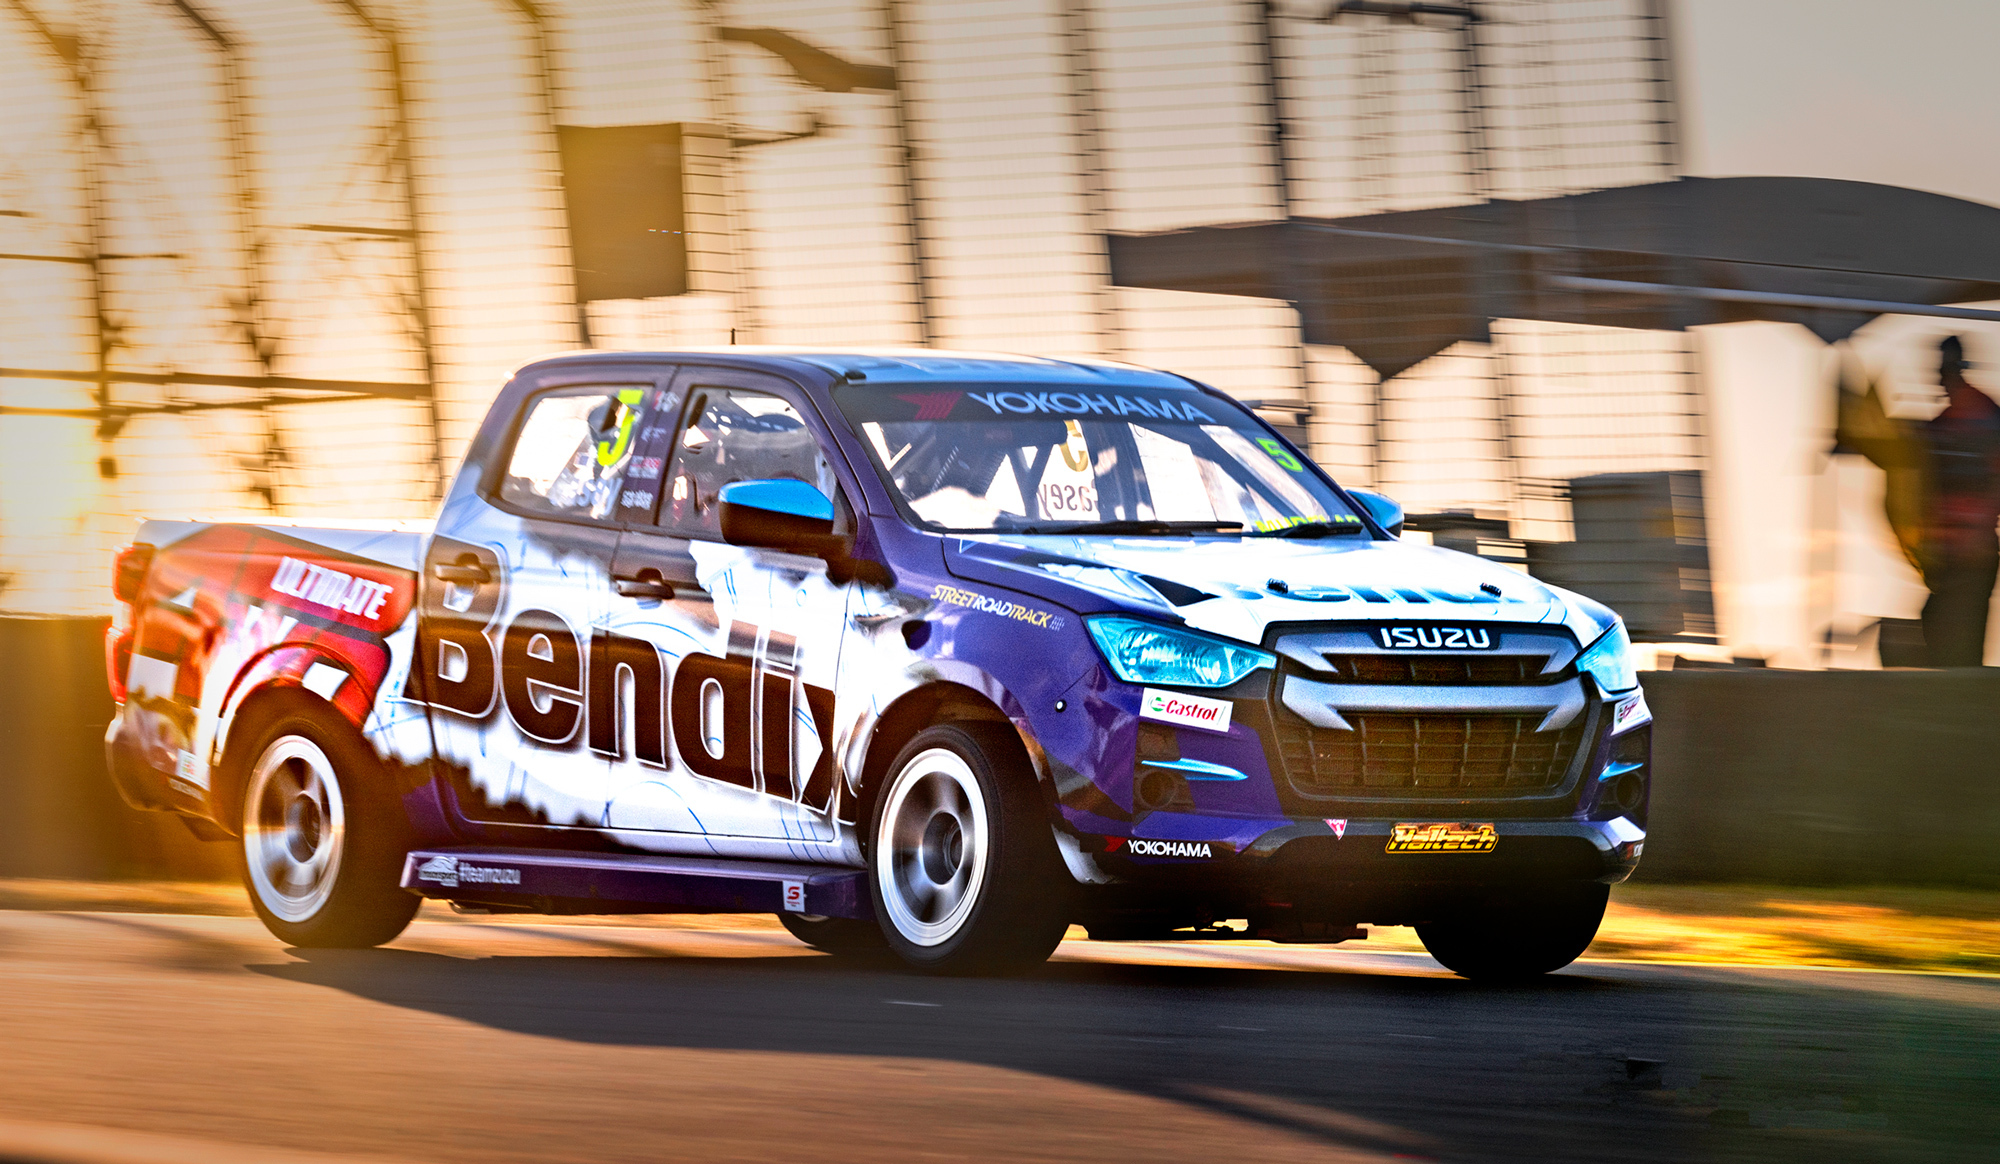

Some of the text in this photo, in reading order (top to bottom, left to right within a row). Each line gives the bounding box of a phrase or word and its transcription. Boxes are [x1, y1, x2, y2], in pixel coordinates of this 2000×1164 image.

[967, 391, 1217, 423] YOKOHAMA
[1255, 437, 1303, 472] 5
[270, 555, 394, 620] ULTIMATE
[1380, 627, 1490, 648] ISUZU
[1165, 700, 1219, 721] Castrol
[1128, 839, 1212, 858] YOKOHAMA
[1388, 826, 1496, 850] Haltech
